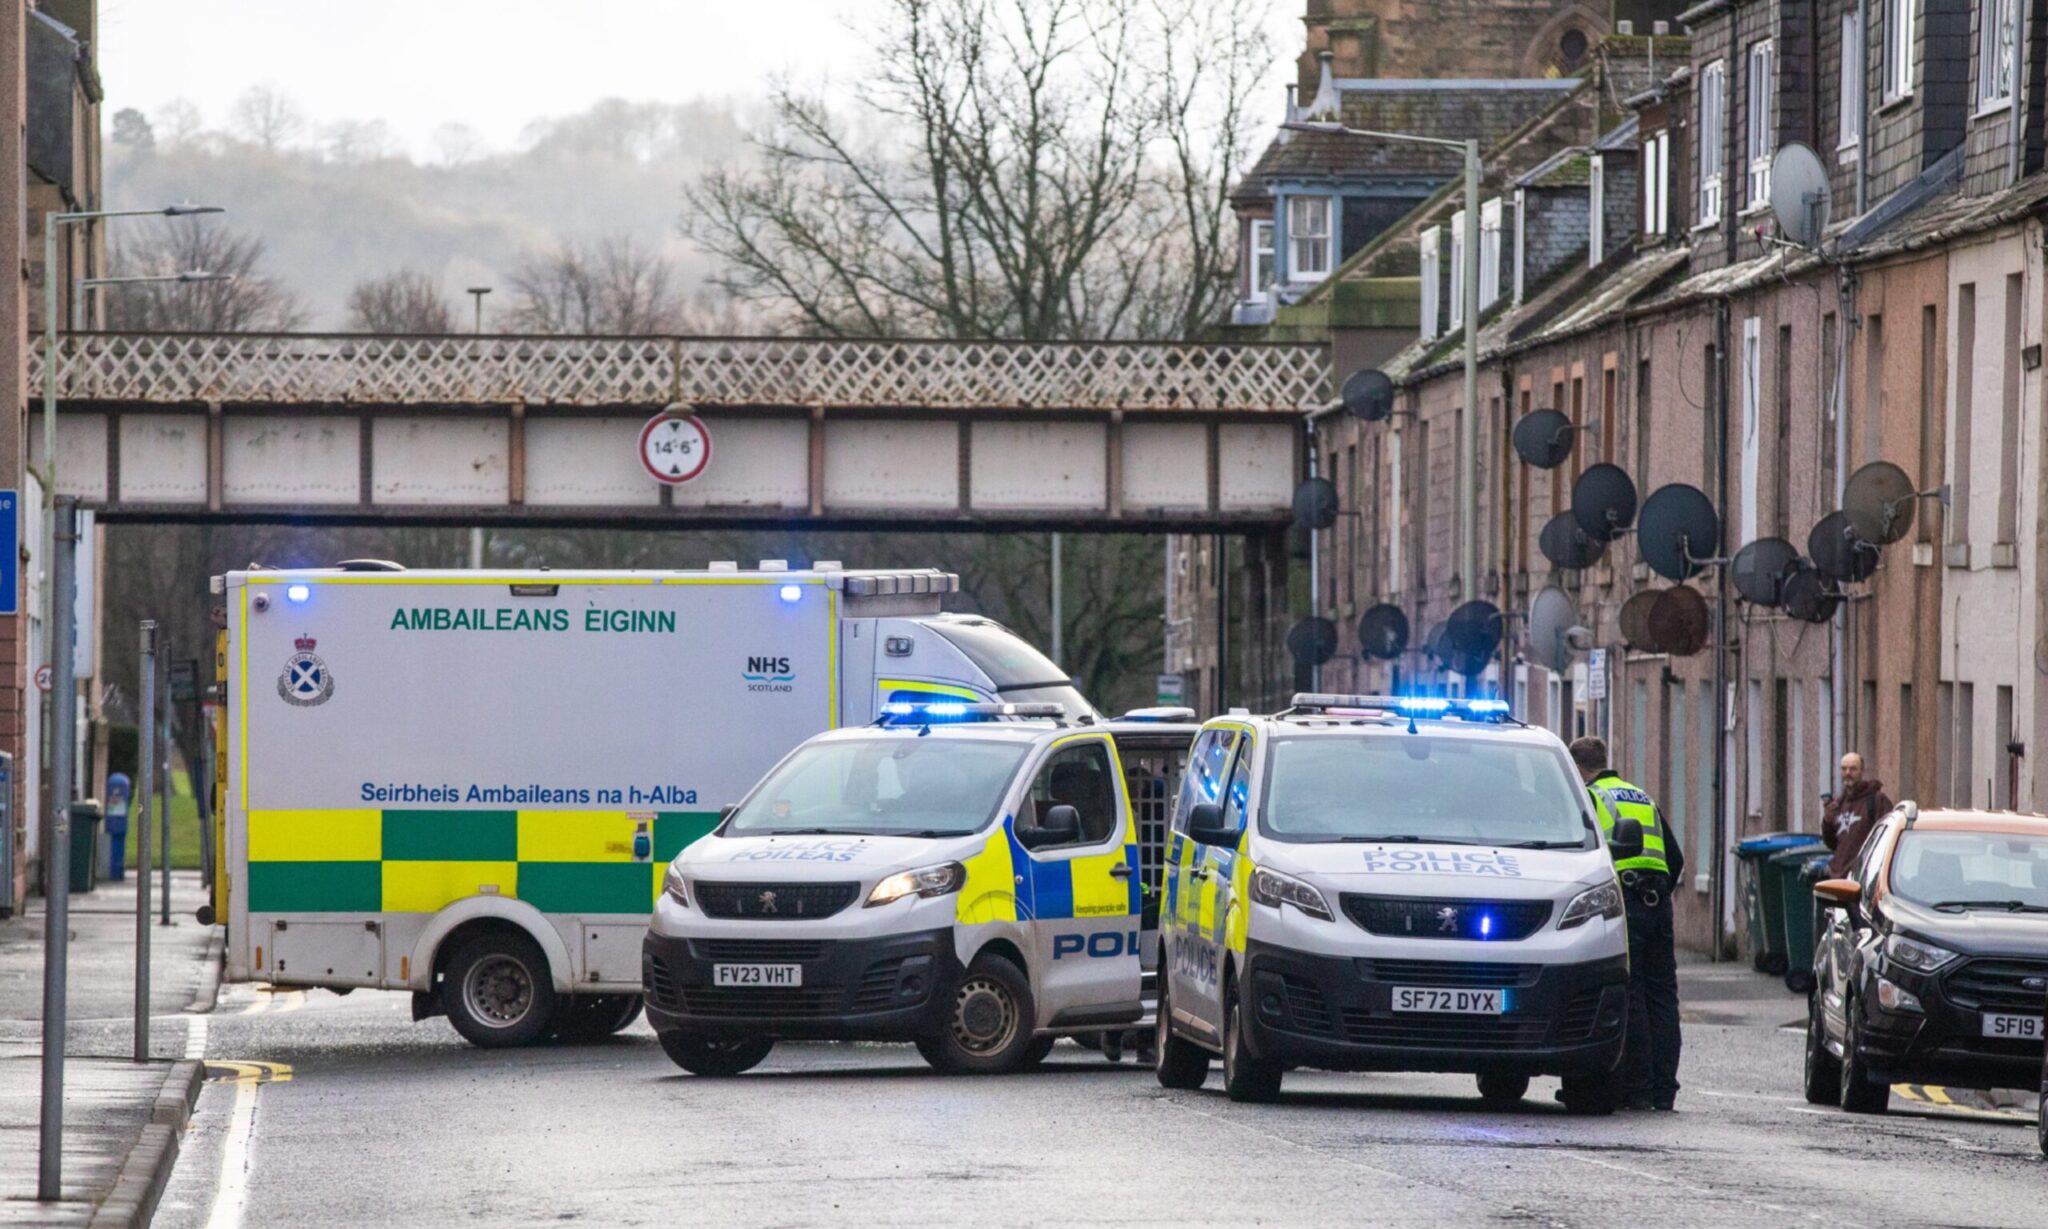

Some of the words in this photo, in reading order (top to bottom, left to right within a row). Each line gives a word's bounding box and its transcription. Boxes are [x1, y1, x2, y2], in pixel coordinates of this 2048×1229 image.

[390, 608, 569, 631] AMBAILEANS
[747, 656, 790, 674] NHS
[747, 684, 793, 692] SCOTLAND
[360, 782, 460, 802] Seirbheis
[465, 784, 590, 804] Ambaileans
[596, 787, 623, 805] na
[628, 786, 698, 805] h-Alba
[1610, 787, 1650, 804] POLICE
[729, 850, 857, 862] POILEAS
[1363, 850, 1519, 866] POLICE
[1366, 861, 1522, 877] POILEAS
[1174, 935, 1217, 986] POLICE
[720, 967, 760, 983] FV23
[764, 967, 794, 983] VHT
[1401, 990, 1451, 1009] SF72
[1457, 992, 1495, 1011] DYX
[1995, 1016, 2035, 1036] SF19
